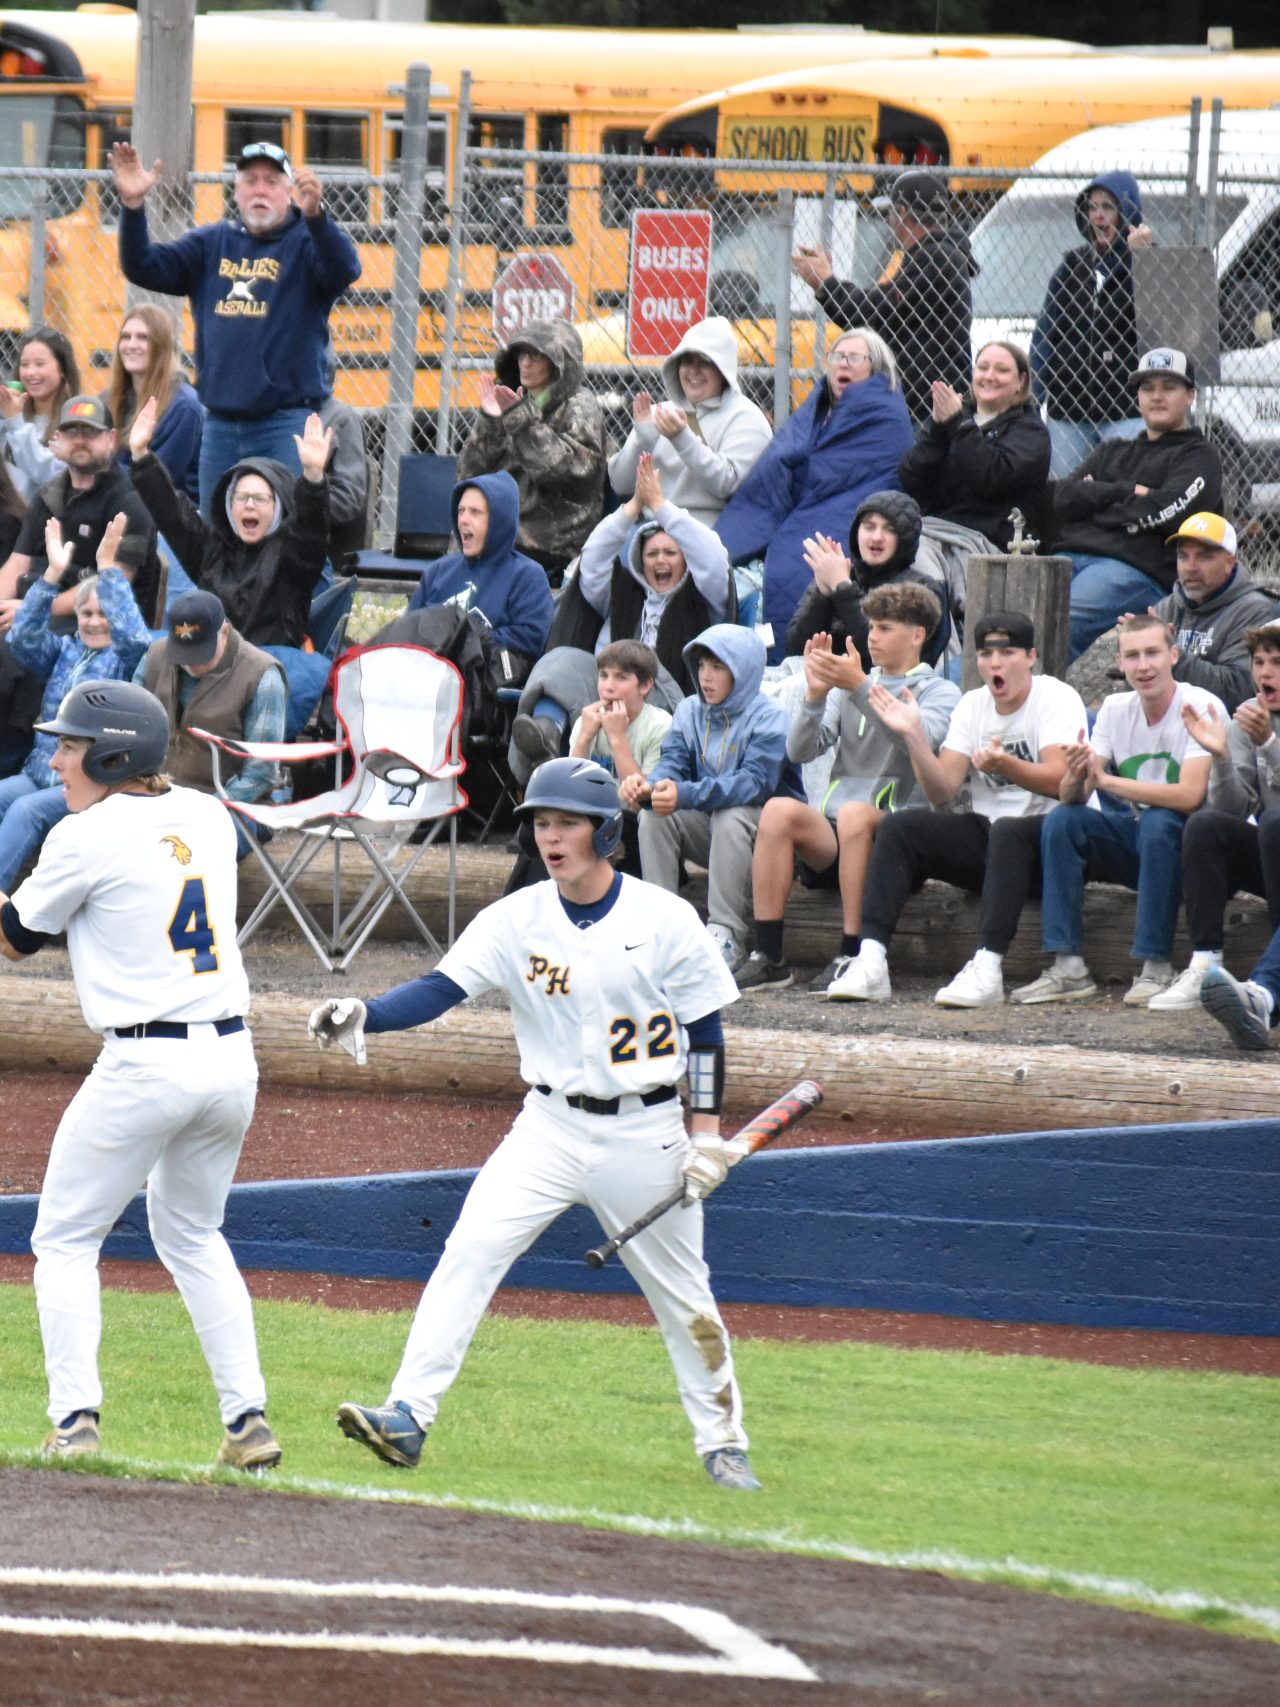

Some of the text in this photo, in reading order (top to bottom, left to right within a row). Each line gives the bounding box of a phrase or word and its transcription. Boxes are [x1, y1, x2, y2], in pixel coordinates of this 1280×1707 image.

[730, 125, 866, 163] SCHOOL BUS
[638, 245, 704, 270] BUSES
[503, 287, 565, 328] STOP
[641, 297, 696, 321] ONLY
[1255, 400, 1280, 420] PLEAS
[1139, 476, 1205, 529] carhartt
[166, 875, 220, 976] 4
[526, 954, 571, 996] PH
[609, 1011, 678, 1066] 22
